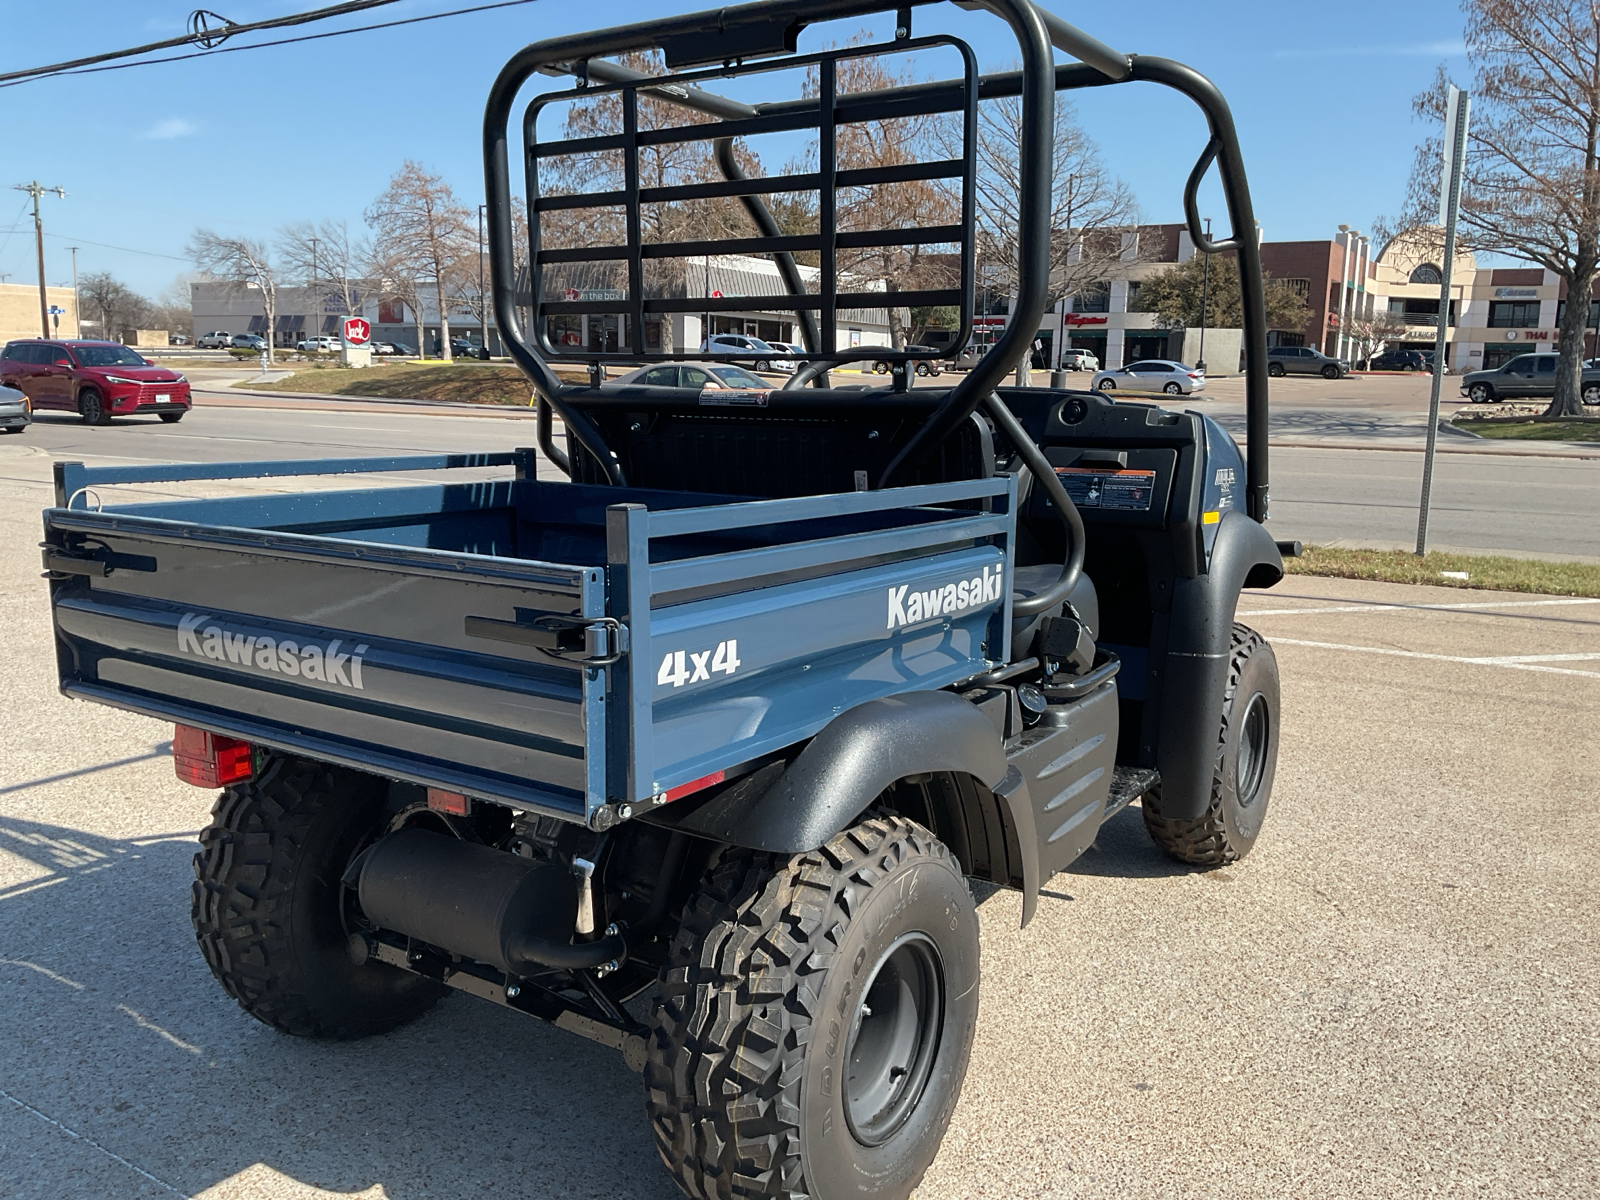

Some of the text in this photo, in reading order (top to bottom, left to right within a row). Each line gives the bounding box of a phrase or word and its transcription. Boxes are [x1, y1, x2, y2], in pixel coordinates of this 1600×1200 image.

[589, 292, 603, 300] the
[604, 292, 620, 300] box
[346, 321, 370, 341] Jack
[1525, 331, 1548, 340] THAI
[887, 563, 1002, 630] Kawasaki
[177, 612, 370, 690] Kawasaki
[657, 639, 741, 688] 4x4
[820, 948, 868, 1098] DURO
